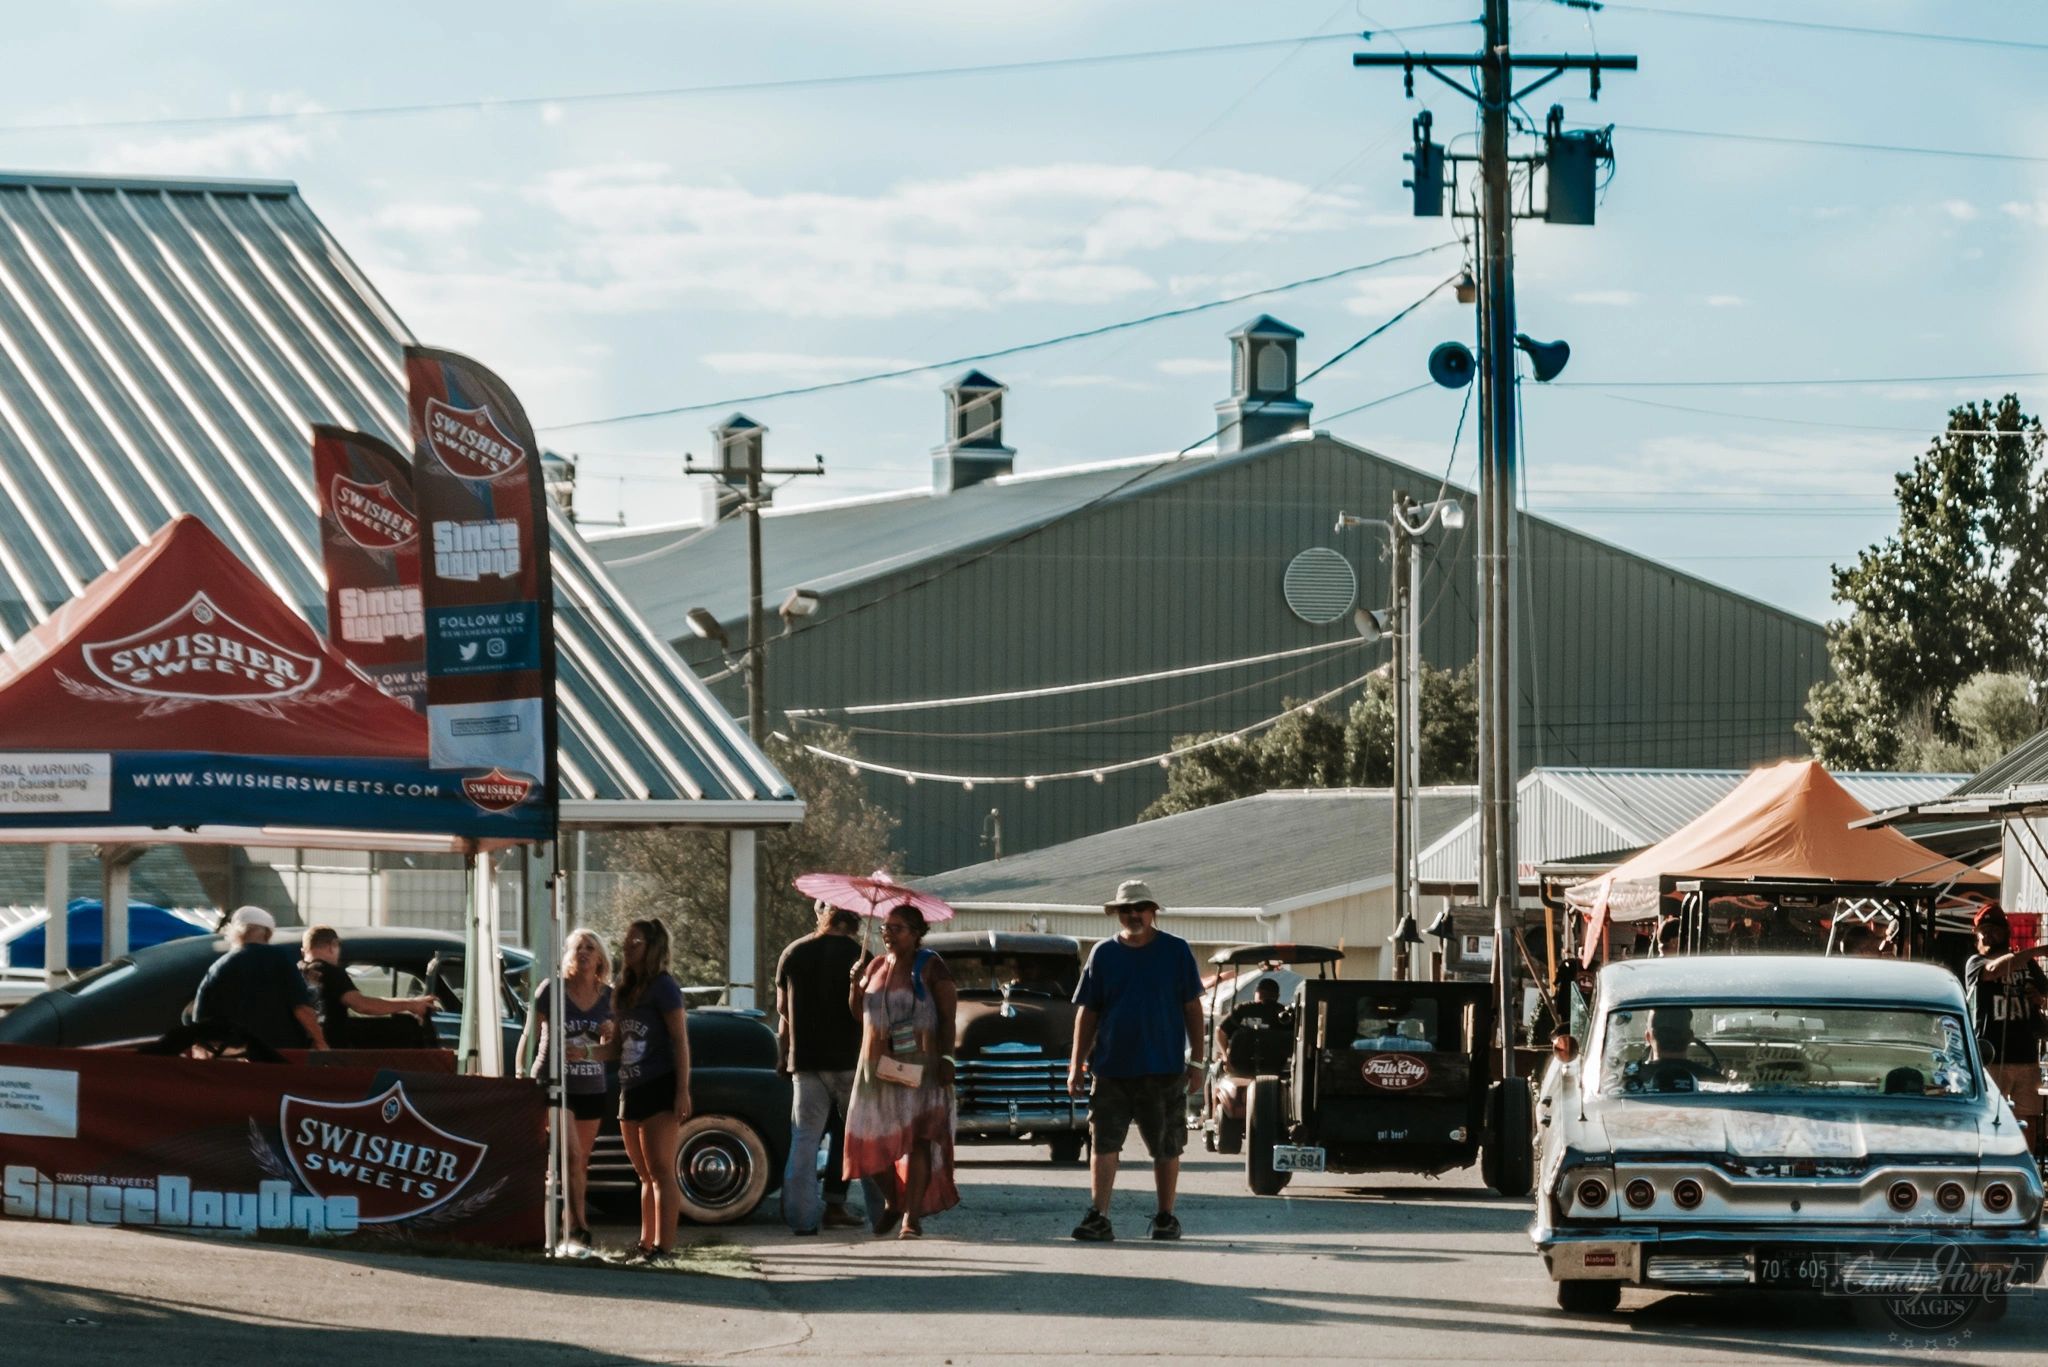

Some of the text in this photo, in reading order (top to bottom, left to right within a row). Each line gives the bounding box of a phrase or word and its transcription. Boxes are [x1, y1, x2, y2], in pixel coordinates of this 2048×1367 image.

[432, 412, 513, 467] SWISHER
[434, 431, 500, 474] SWEETS
[338, 487, 413, 535] SWISHER
[340, 506, 401, 541] SWEETS
[439, 612, 524, 628] FOLLOW US
[111, 633, 300, 681] SWISHER
[131, 658, 286, 688] SWEETS
[18, 777, 55, 789] Cause
[58, 778, 87, 790] Lung
[132, 772, 439, 796] WWW.SWISHERSWEETS.COM
[469, 783, 523, 795] SWISHER
[1365, 1060, 1424, 1079] Falls City
[1382, 1078, 1407, 1086] BEER
[1378, 1130, 1387, 1140] got
[297, 1118, 458, 1182] SWISHER
[56, 1173, 155, 1187] SWISHER SWEETS
[304, 1154, 438, 1199] SWEETS
